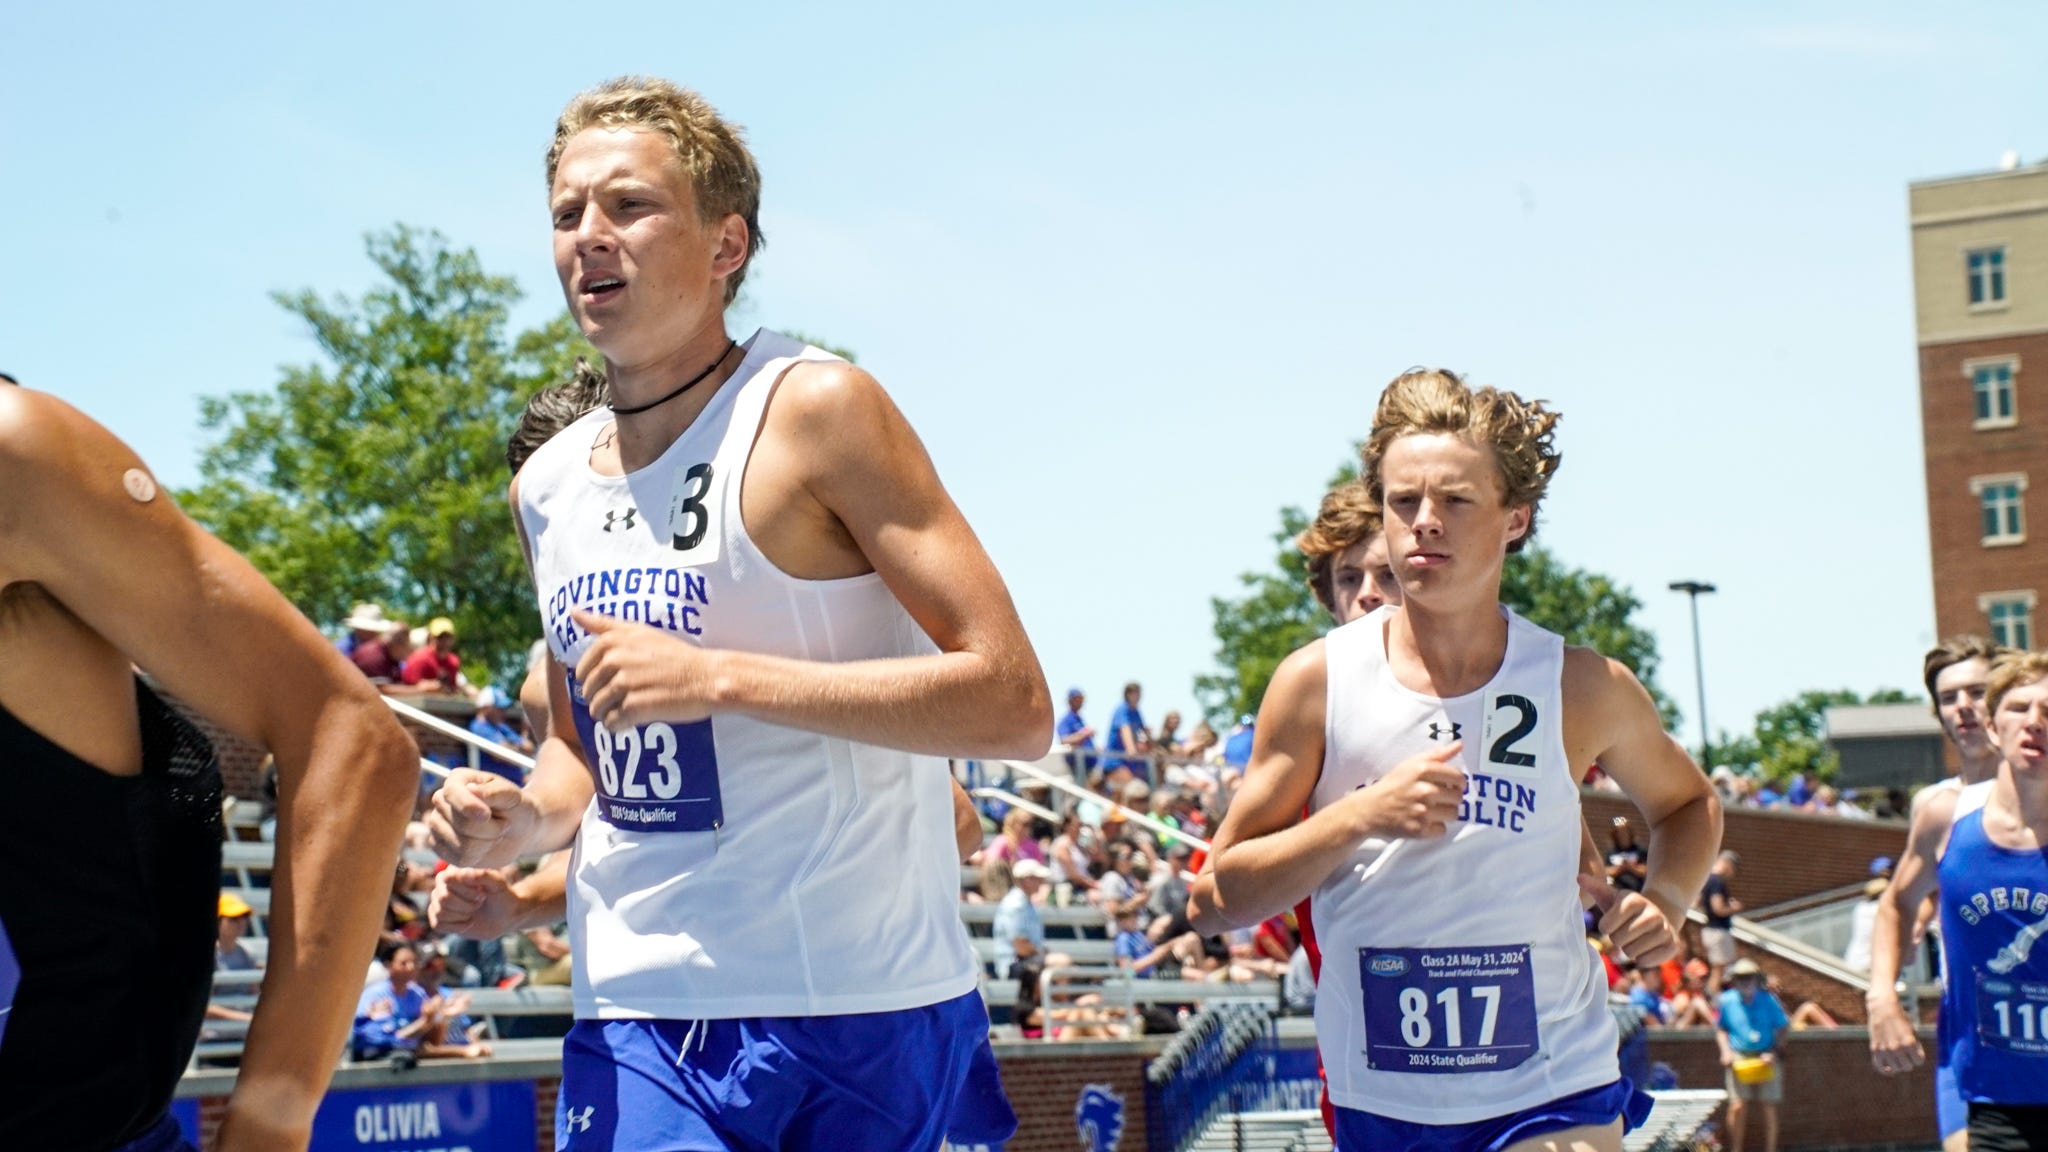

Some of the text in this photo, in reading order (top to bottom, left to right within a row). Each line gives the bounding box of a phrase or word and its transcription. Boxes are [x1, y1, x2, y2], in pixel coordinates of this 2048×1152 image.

[673, 463, 714, 551] 3
[550, 568, 709, 627] COVINGTON
[1489, 694, 1538, 768] 2
[594, 721, 682, 800] 823
[640, 807, 677, 824] Qualifier
[1421, 952, 1524, 968] Class 2A May 31, 2024
[1428, 966, 1520, 978] Track and Field Championships
[1400, 986, 1501, 1048] 817
[1409, 1052, 1498, 1067] 2024 State Qualifier
[355, 1101, 441, 1143] OLIVIA
